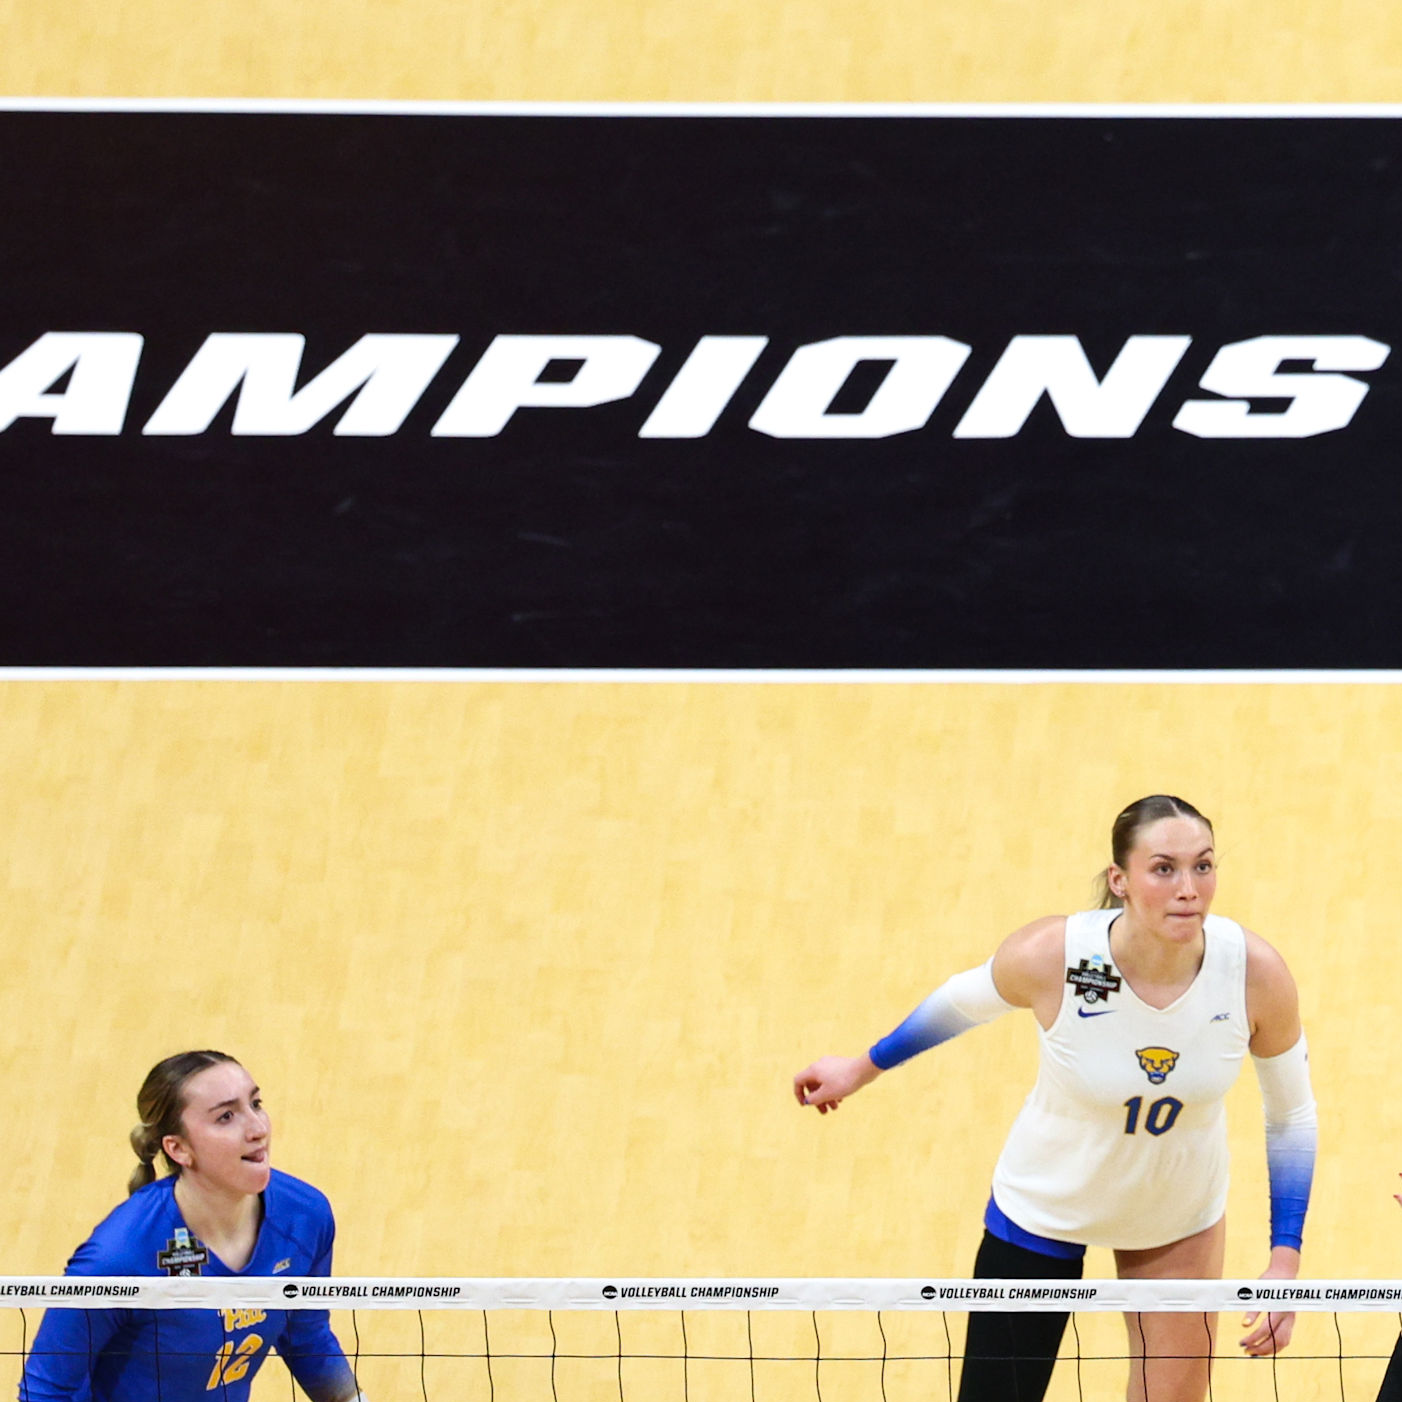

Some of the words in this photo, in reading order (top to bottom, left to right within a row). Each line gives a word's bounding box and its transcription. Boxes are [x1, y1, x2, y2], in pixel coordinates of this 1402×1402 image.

[0, 332, 1390, 439] AMPIONS
[1123, 1095, 1184, 1137] 10
[0, 1285, 47, 1296] LEYBALL
[50, 1285, 140, 1297] CHAMPIONSHIP
[303, 1286, 367, 1297] VOLLEYBALL
[371, 1287, 461, 1298] CHAMPIONSHIP
[621, 1287, 687, 1298] VOLLEYBALL
[690, 1287, 779, 1298] CHAMPIONSHIP
[940, 1288, 1005, 1299] VOLLEYBALL
[1008, 1289, 1097, 1300] CHAMPIONSHIP
[1256, 1289, 1321, 1300] VOLLEYBALL
[206, 1333, 264, 1391] 12
